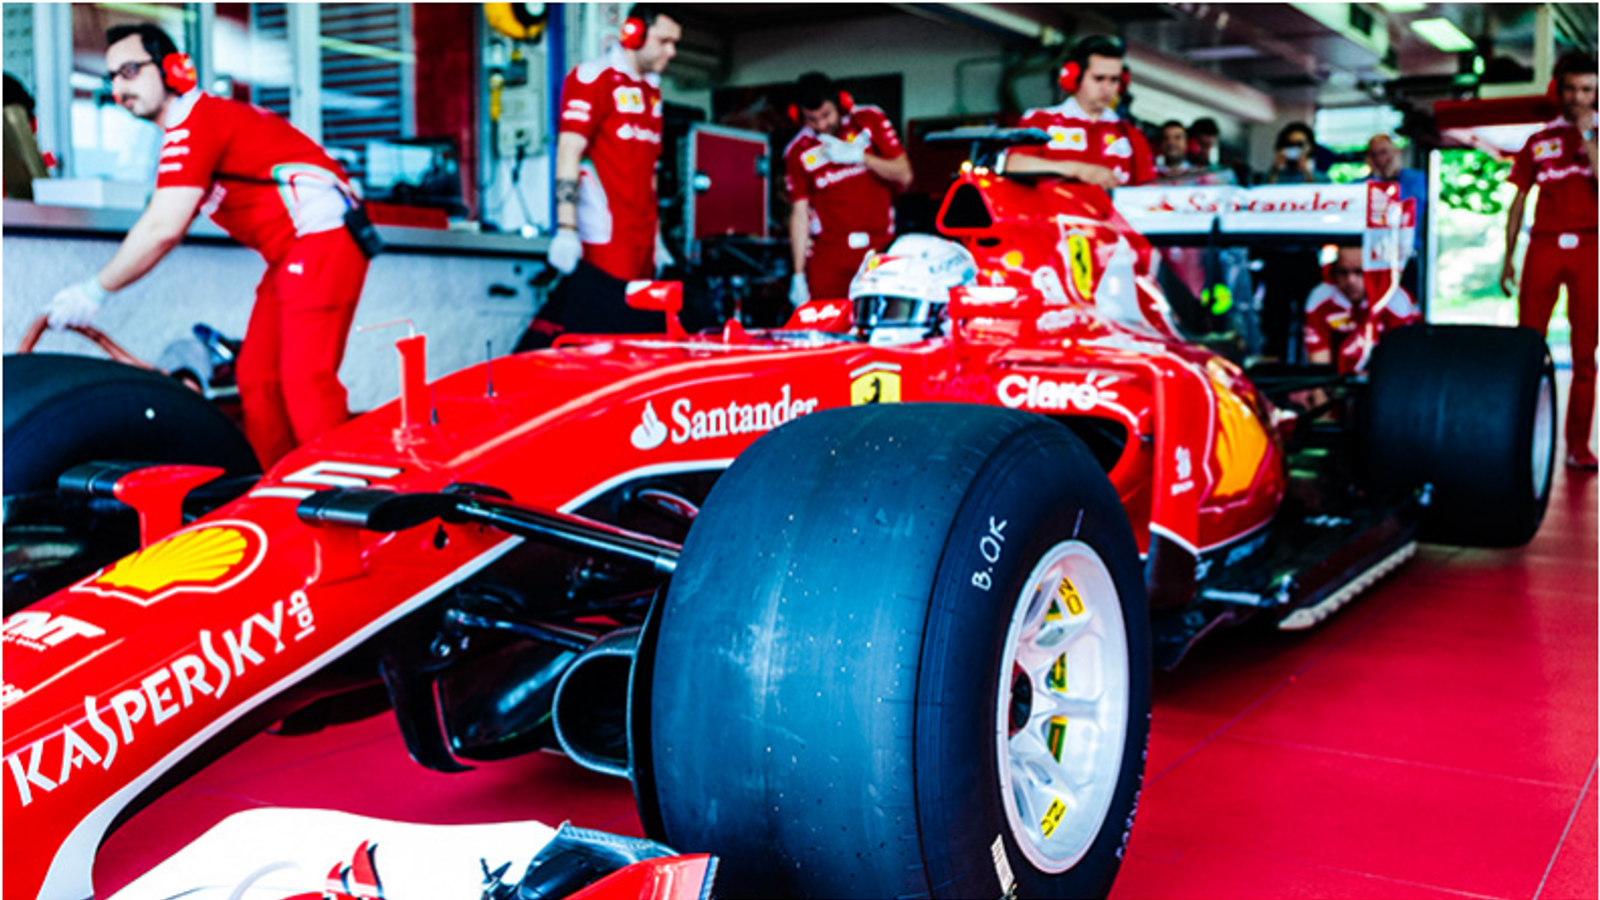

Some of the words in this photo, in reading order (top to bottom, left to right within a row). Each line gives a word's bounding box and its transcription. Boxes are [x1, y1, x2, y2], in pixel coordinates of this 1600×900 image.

[671, 383, 818, 444] Santander
[7, 600, 285, 807] KASPERSKY
[287, 590, 316, 641] lab
